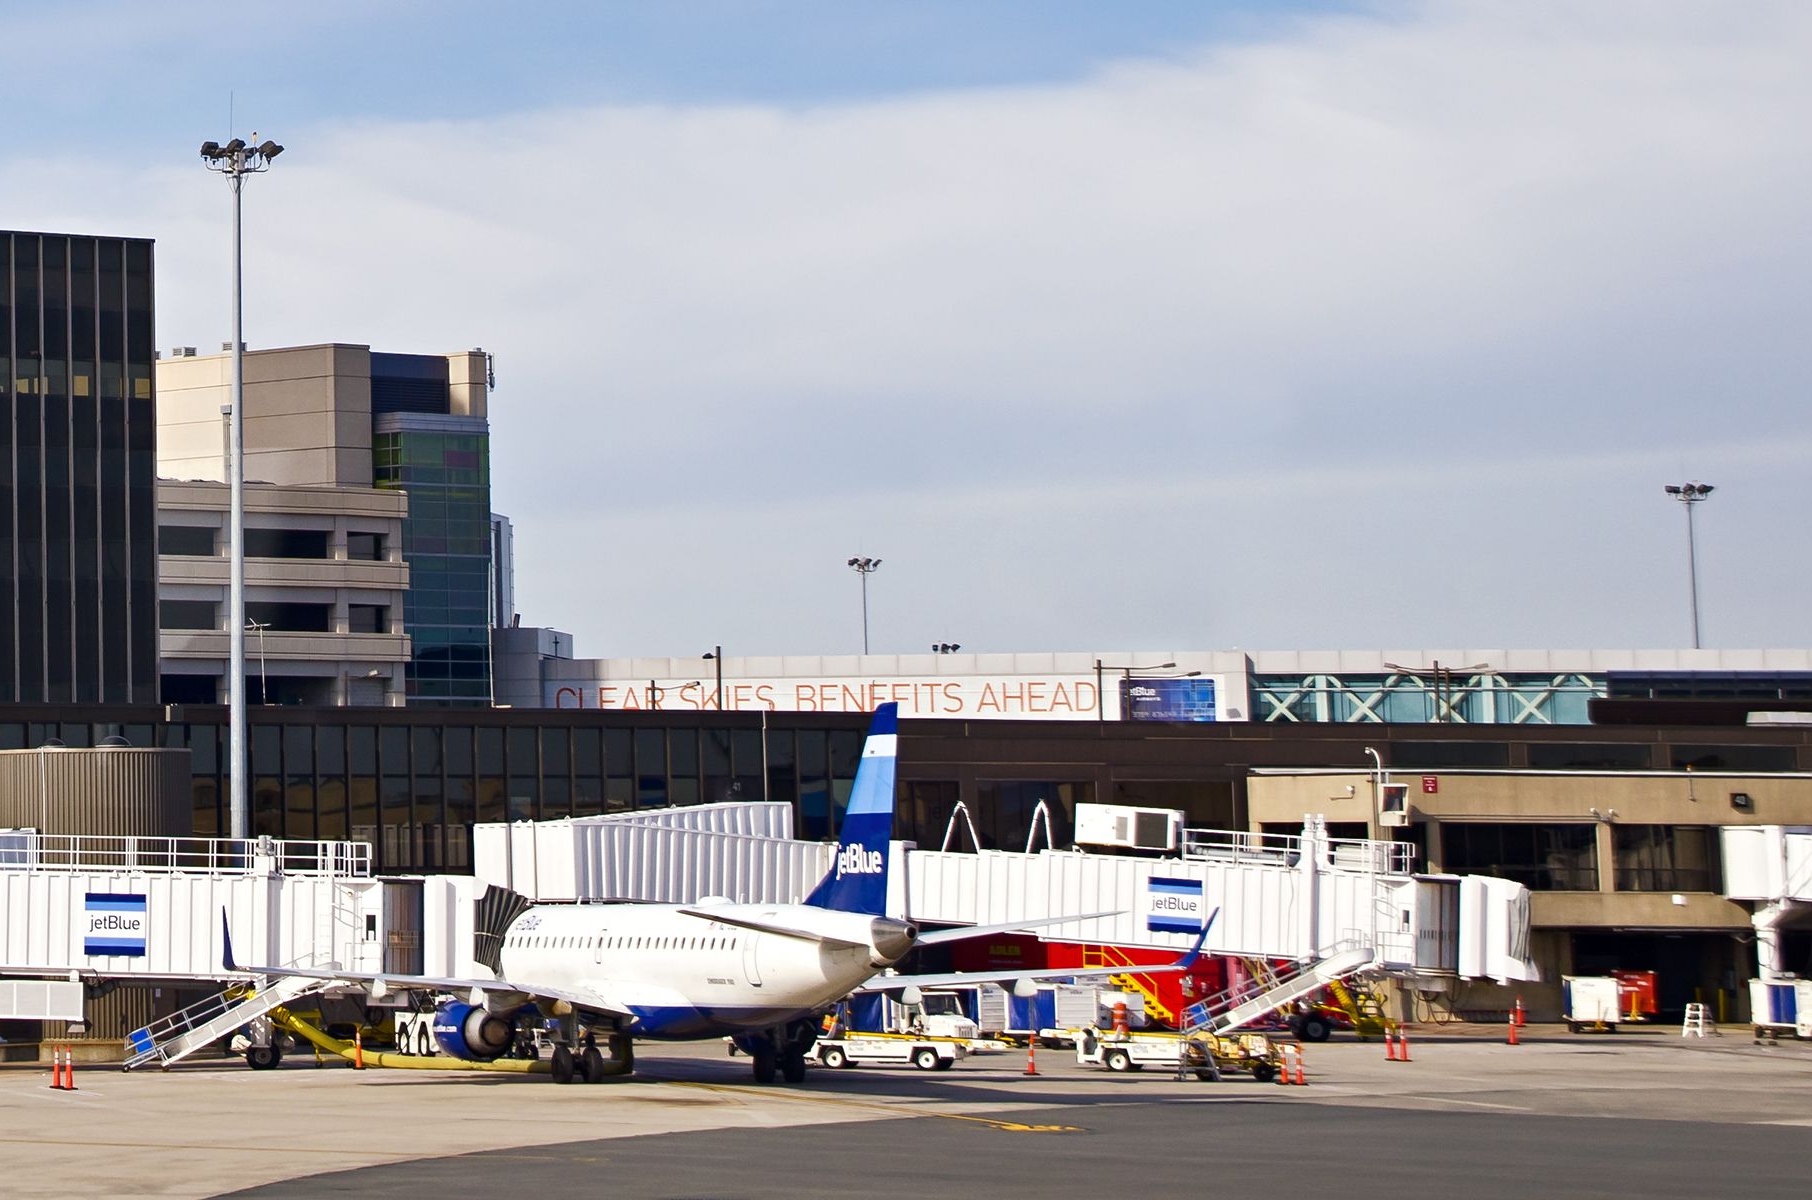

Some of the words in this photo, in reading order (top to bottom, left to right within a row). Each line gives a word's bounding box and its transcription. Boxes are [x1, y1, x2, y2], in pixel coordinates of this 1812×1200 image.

[795, 683, 964, 713] BENEFITS
[976, 682, 1097, 712] AHEAD
[836, 843, 883, 881] jetBlue
[1151, 896, 1197, 911] jetBlue
[89, 914, 141, 933] jetBlue
